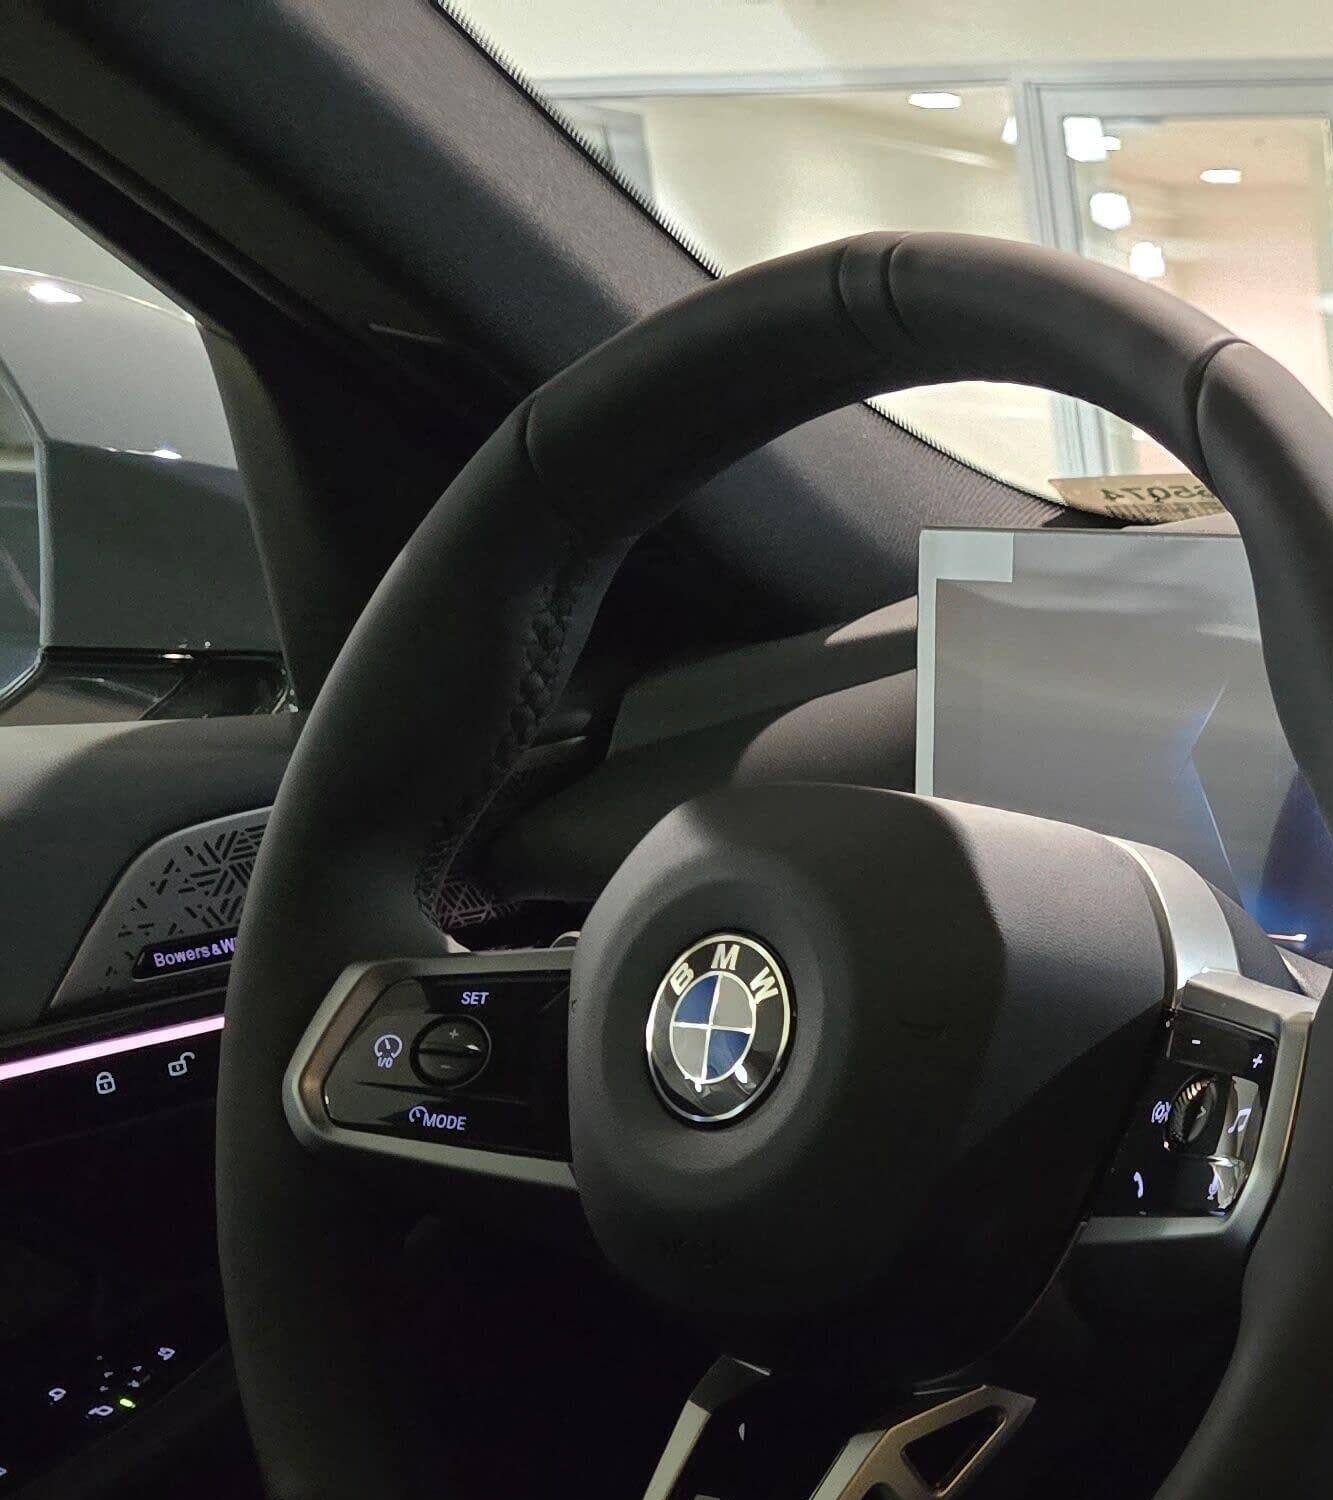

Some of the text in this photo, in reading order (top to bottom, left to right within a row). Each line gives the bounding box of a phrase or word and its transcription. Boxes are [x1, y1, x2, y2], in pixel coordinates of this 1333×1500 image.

[153, 945, 211, 968] Bowers
[670, 943, 779, 1005] BMW
[460, 991, 489, 1005] SET
[423, 1111, 467, 1131] MODE
